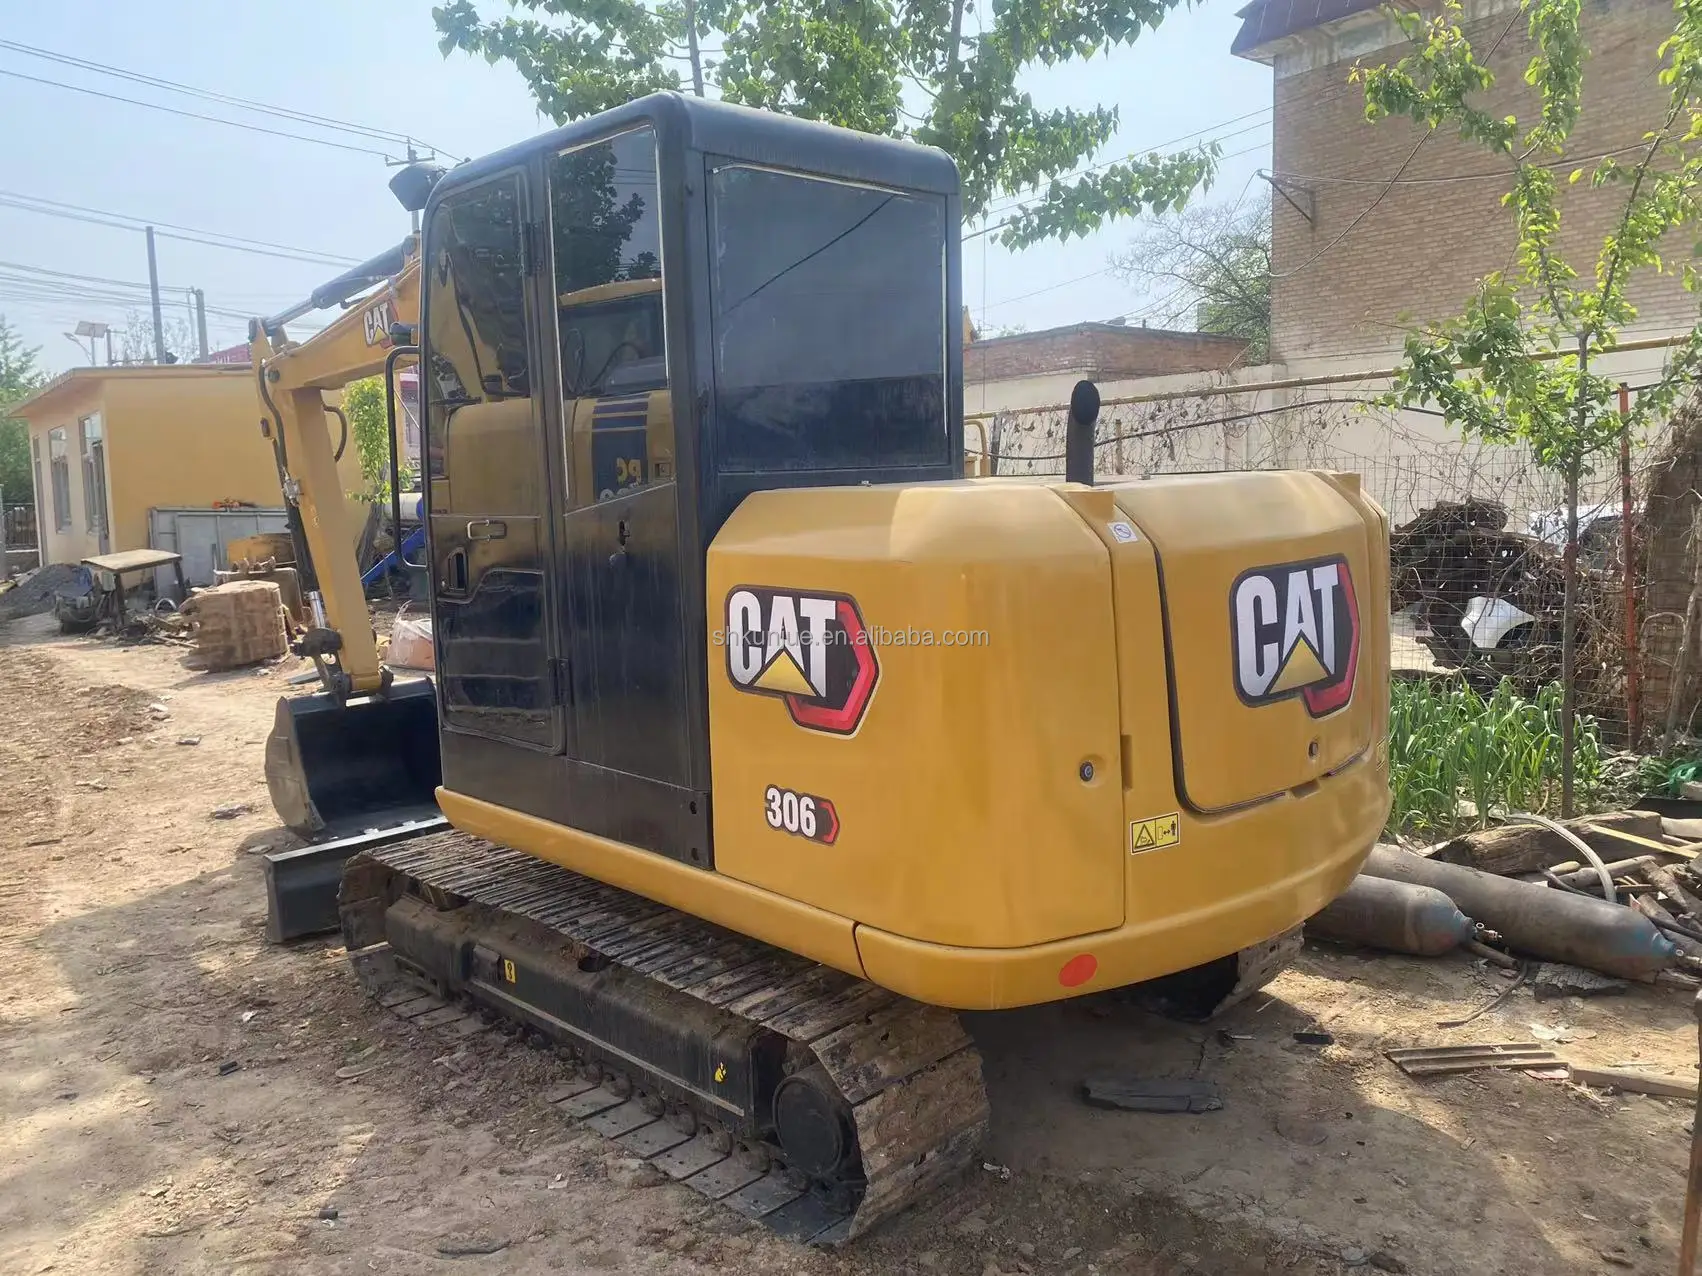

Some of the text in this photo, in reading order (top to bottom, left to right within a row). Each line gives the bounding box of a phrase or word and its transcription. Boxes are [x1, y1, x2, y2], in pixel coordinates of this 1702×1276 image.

[364, 302, 389, 345] CAT
[729, 590, 836, 698] CAT
[1236, 564, 1339, 697] CAT
[766, 787, 817, 838] 306
